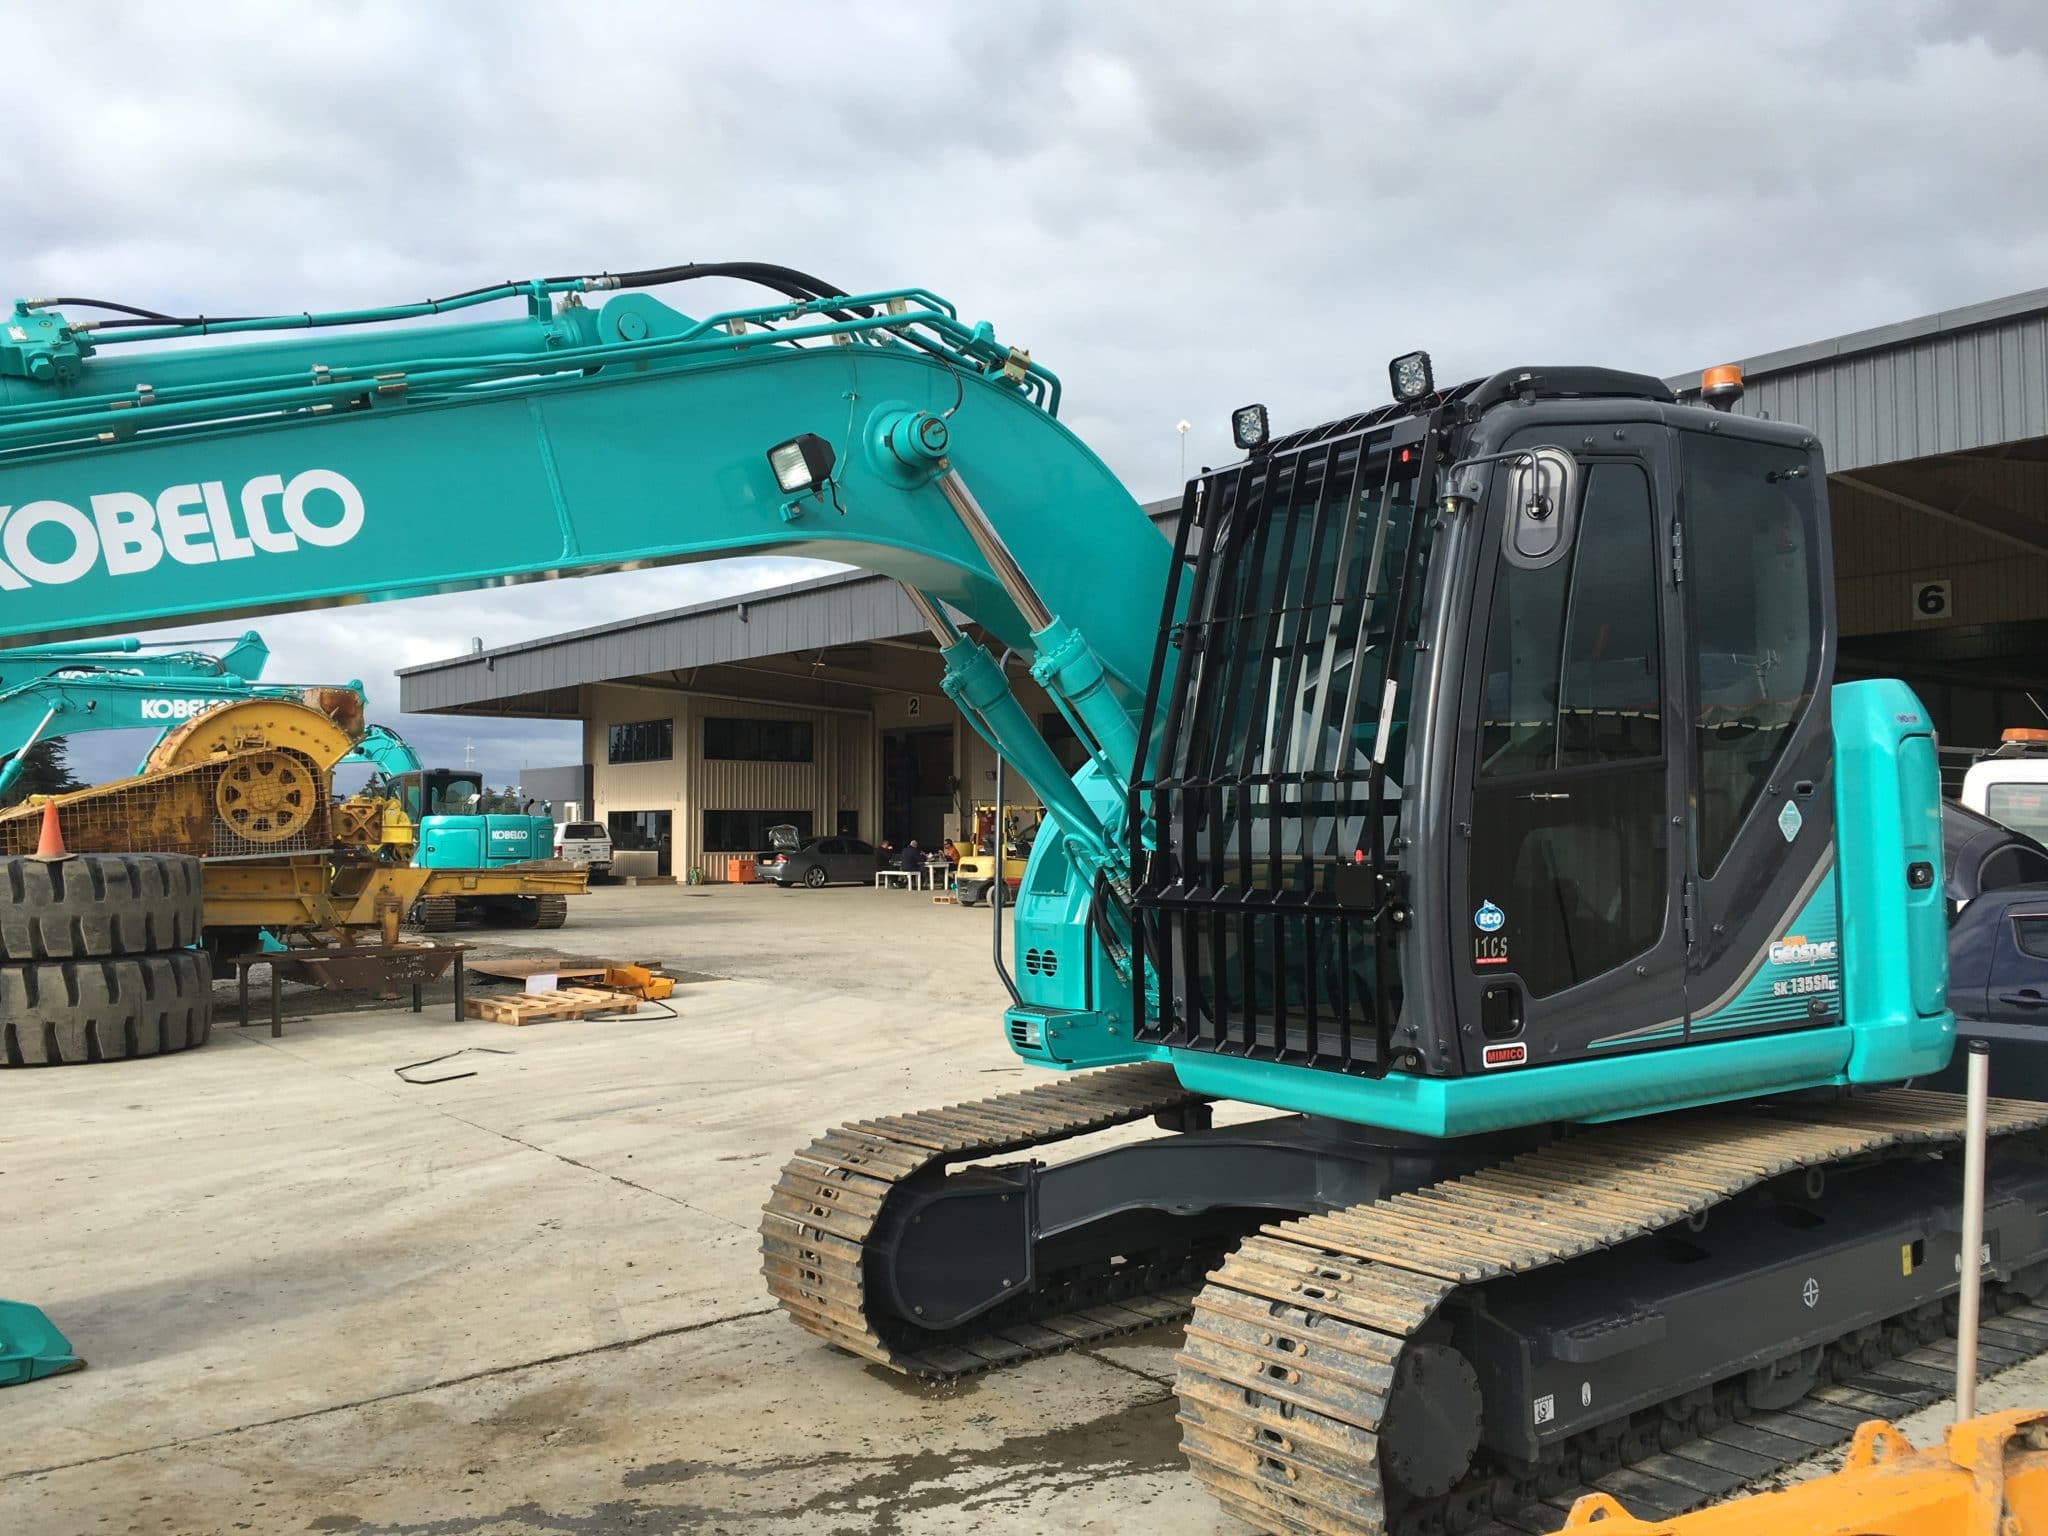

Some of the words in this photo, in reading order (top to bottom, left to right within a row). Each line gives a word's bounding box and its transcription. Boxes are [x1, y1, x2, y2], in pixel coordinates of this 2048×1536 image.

[1918, 584, 1945, 614] 6
[909, 698, 918, 714] 2
[1480, 912, 1502, 925] ECO
[1475, 936, 1508, 958] ITCS
[1773, 981, 1788, 996] SK
[1487, 1048, 1524, 1063] MIMICO
